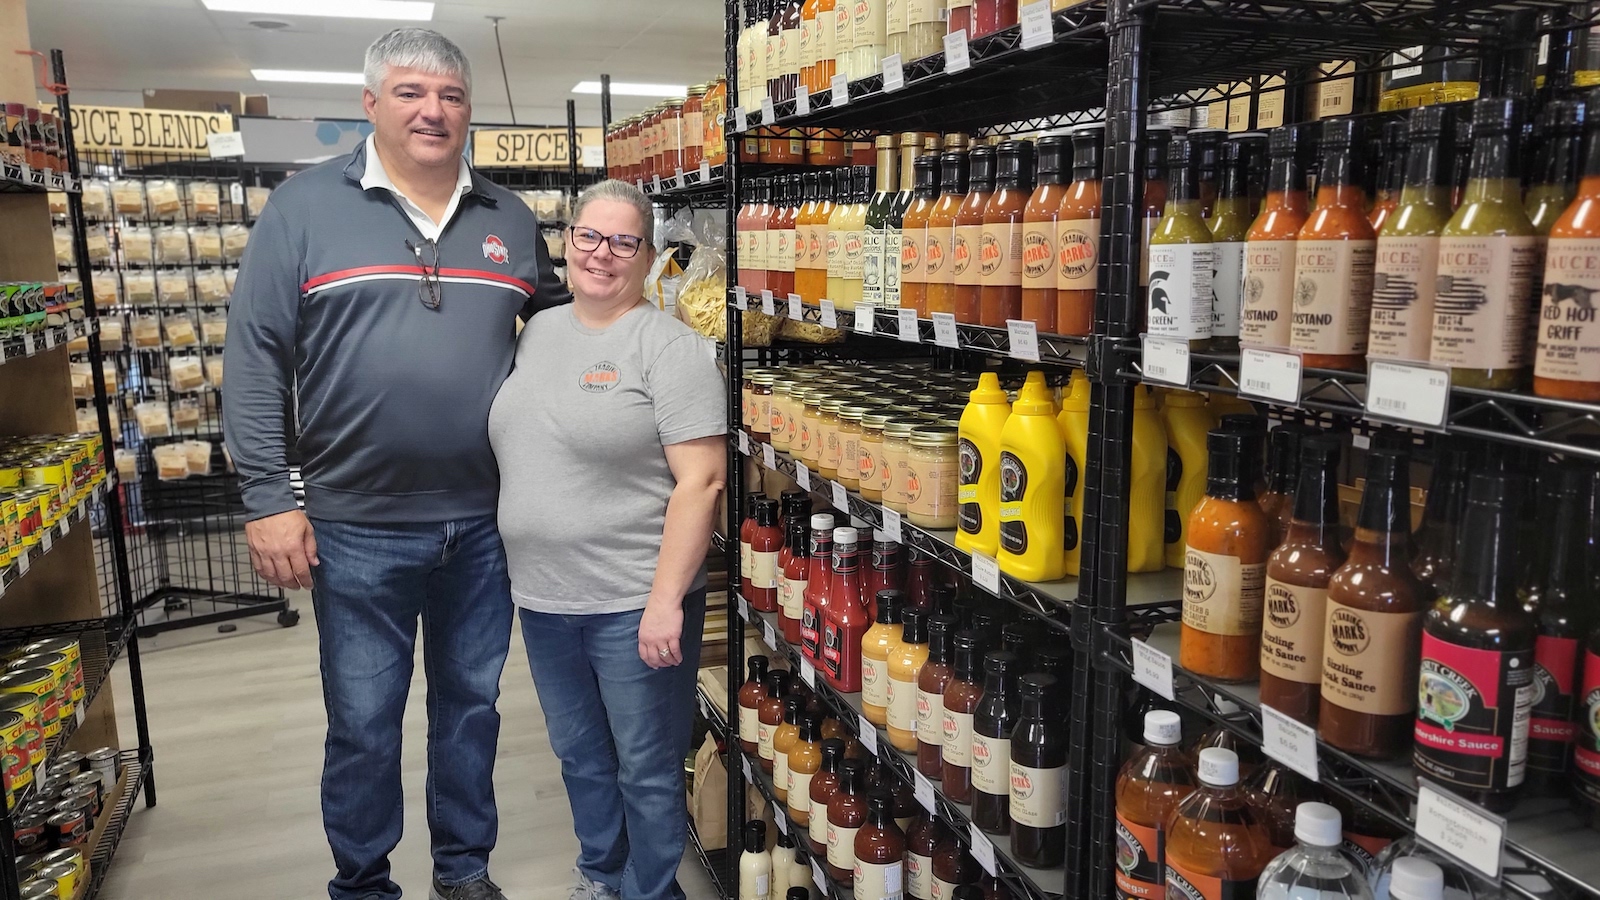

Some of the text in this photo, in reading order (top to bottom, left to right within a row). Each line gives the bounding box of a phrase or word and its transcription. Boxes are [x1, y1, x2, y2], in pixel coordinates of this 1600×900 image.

[864, 236, 879, 245] RLIC
[1543, 305, 1599, 322] RED HOT
[1547, 325, 1584, 340] GRIFF
[1264, 629, 1295, 651] Sizzling
[1275, 647, 1307, 664] Sauce
[1327, 656, 1364, 680] Sizzling
[1341, 676, 1377, 694] Sauce
[1440, 665, 1478, 699] CREEK
[1533, 723, 1573, 735] Sauce
[1458, 738, 1499, 750] Sauce
[1120, 825, 1144, 854] CREEK
